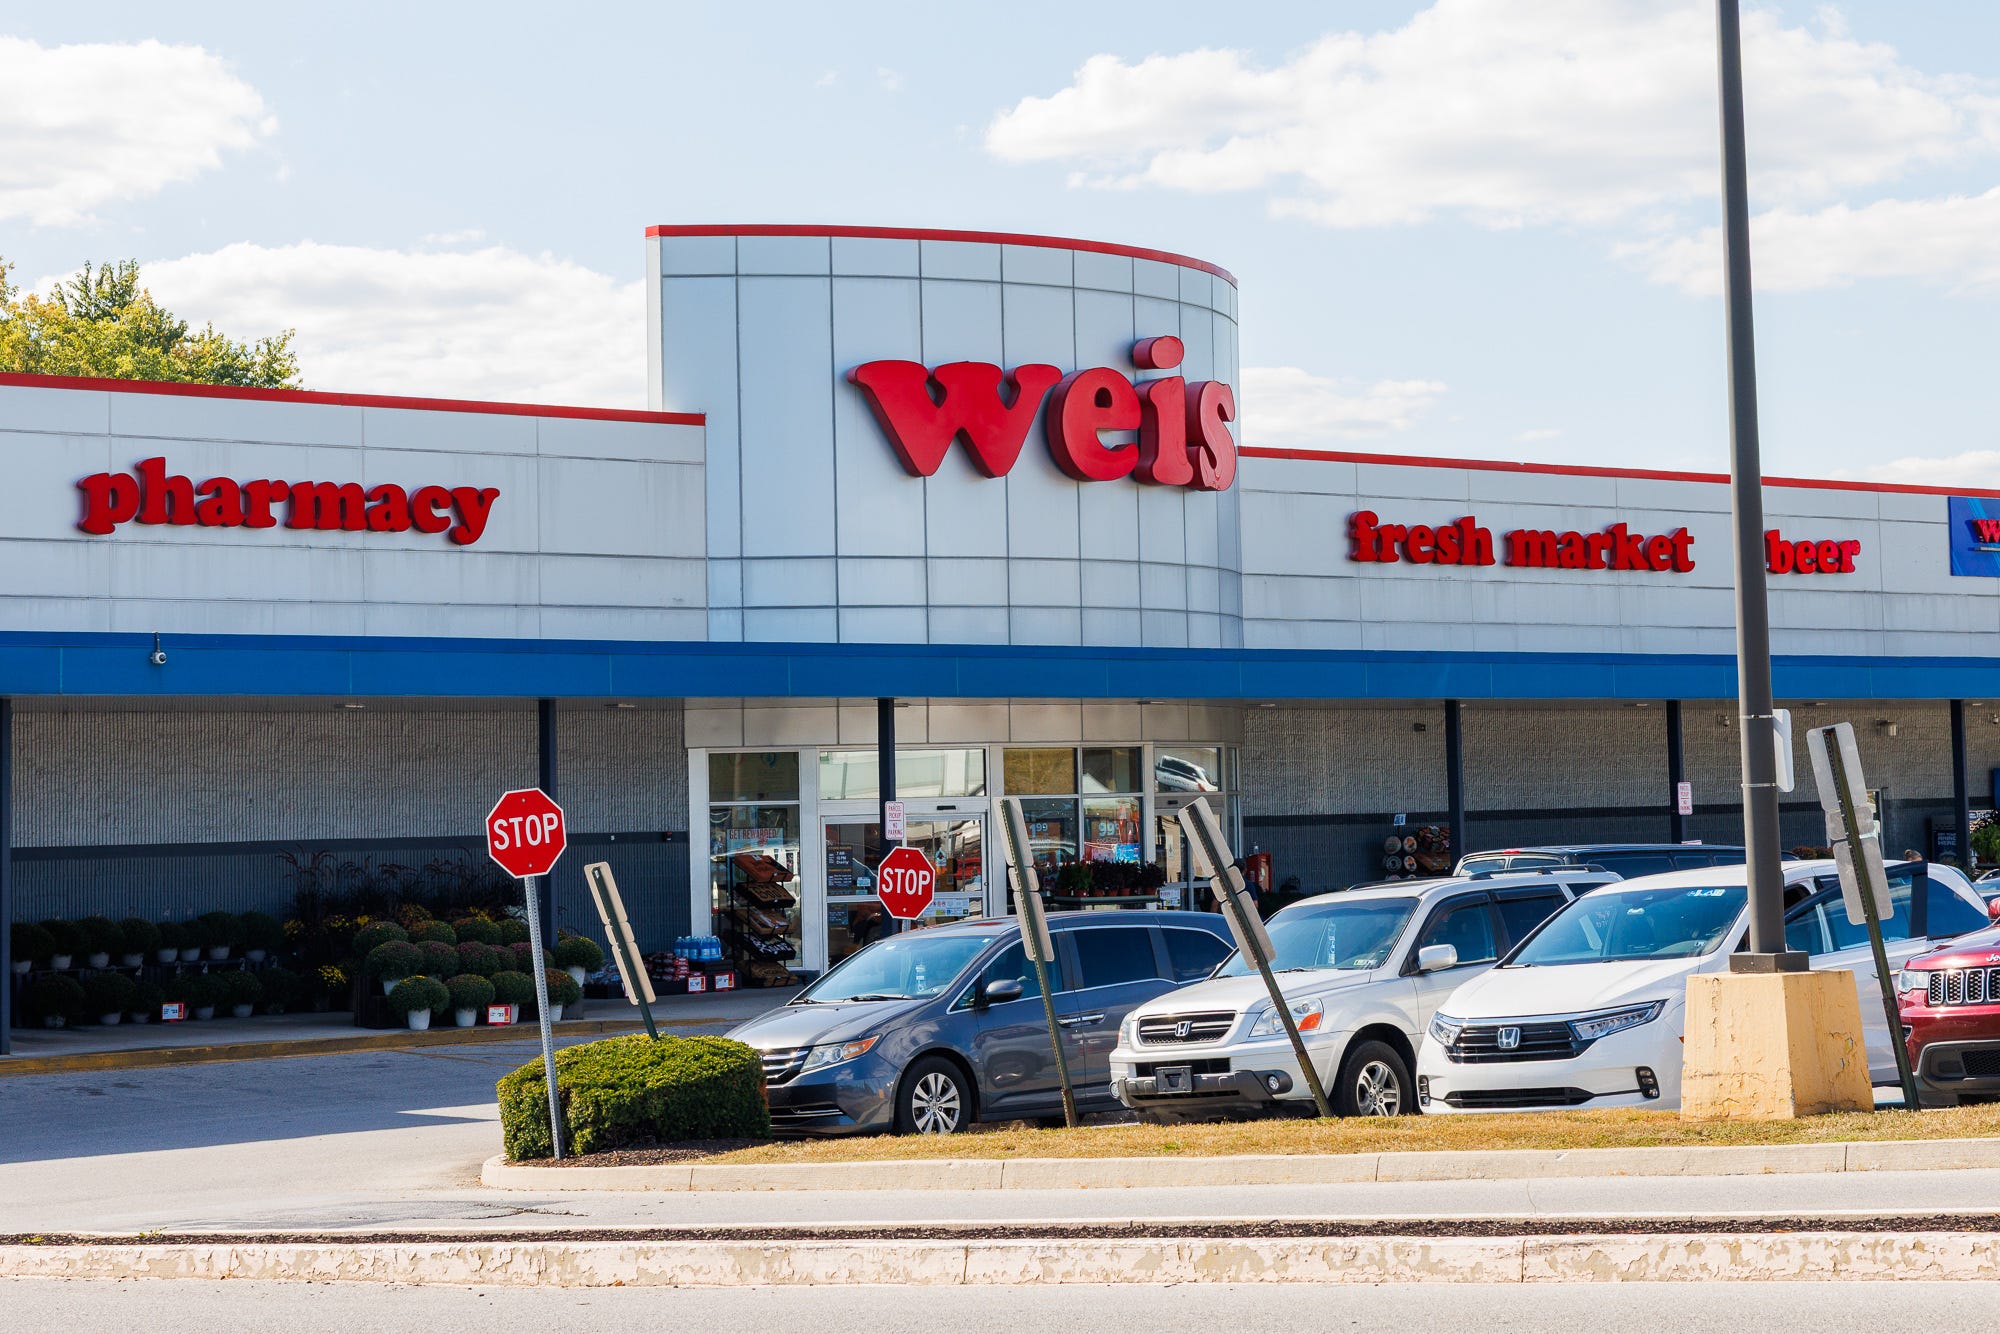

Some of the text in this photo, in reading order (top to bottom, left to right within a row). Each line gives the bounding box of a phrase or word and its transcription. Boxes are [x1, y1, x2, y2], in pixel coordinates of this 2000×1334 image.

[850, 336, 1237, 491] weis
[78, 457, 500, 545] pharmacy
[1350, 511, 1695, 573] fresh market
[1764, 529, 1861, 574] beer
[493, 812, 559, 850] STOP
[729, 829, 741, 840] GET
[881, 867, 931, 896] STOP
